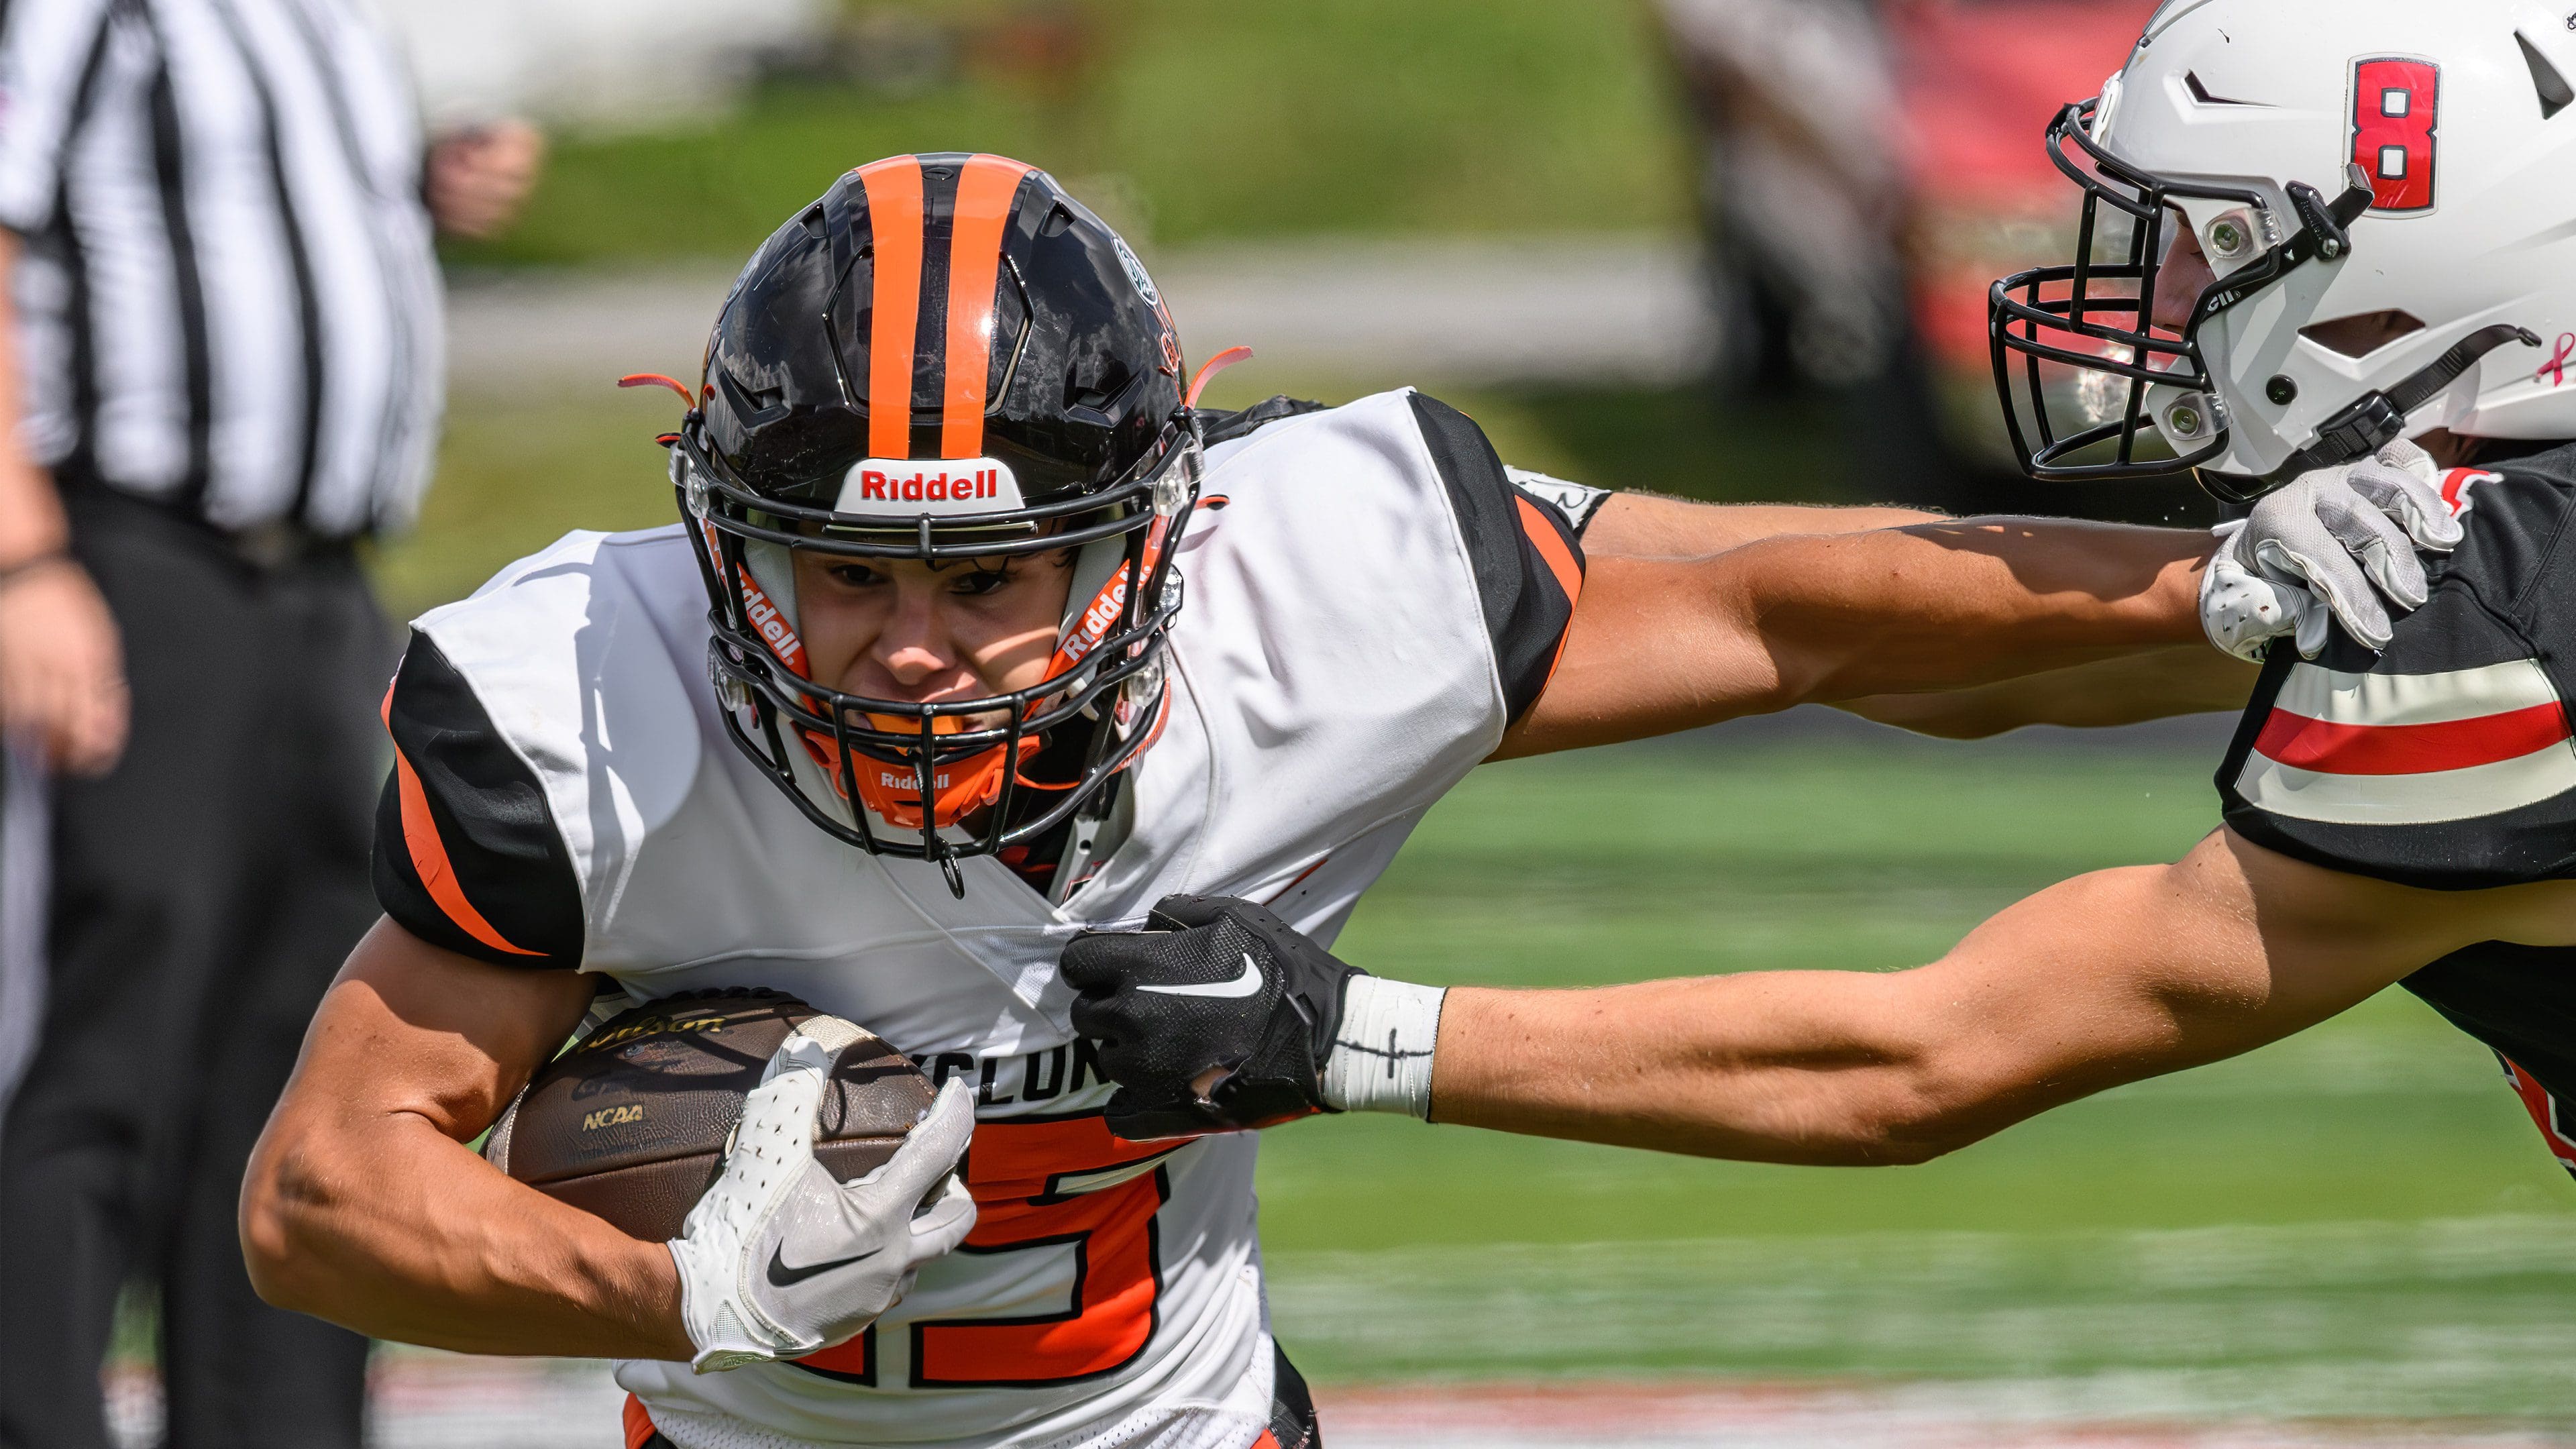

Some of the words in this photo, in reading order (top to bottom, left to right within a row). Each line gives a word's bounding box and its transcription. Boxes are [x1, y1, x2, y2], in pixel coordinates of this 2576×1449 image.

[2350, 56, 2440, 212] 8
[861, 469, 997, 500] Riddell
[738, 569, 801, 659] ddell
[881, 772, 949, 790] Ridll
[582, 1104, 644, 1132] NCAA
